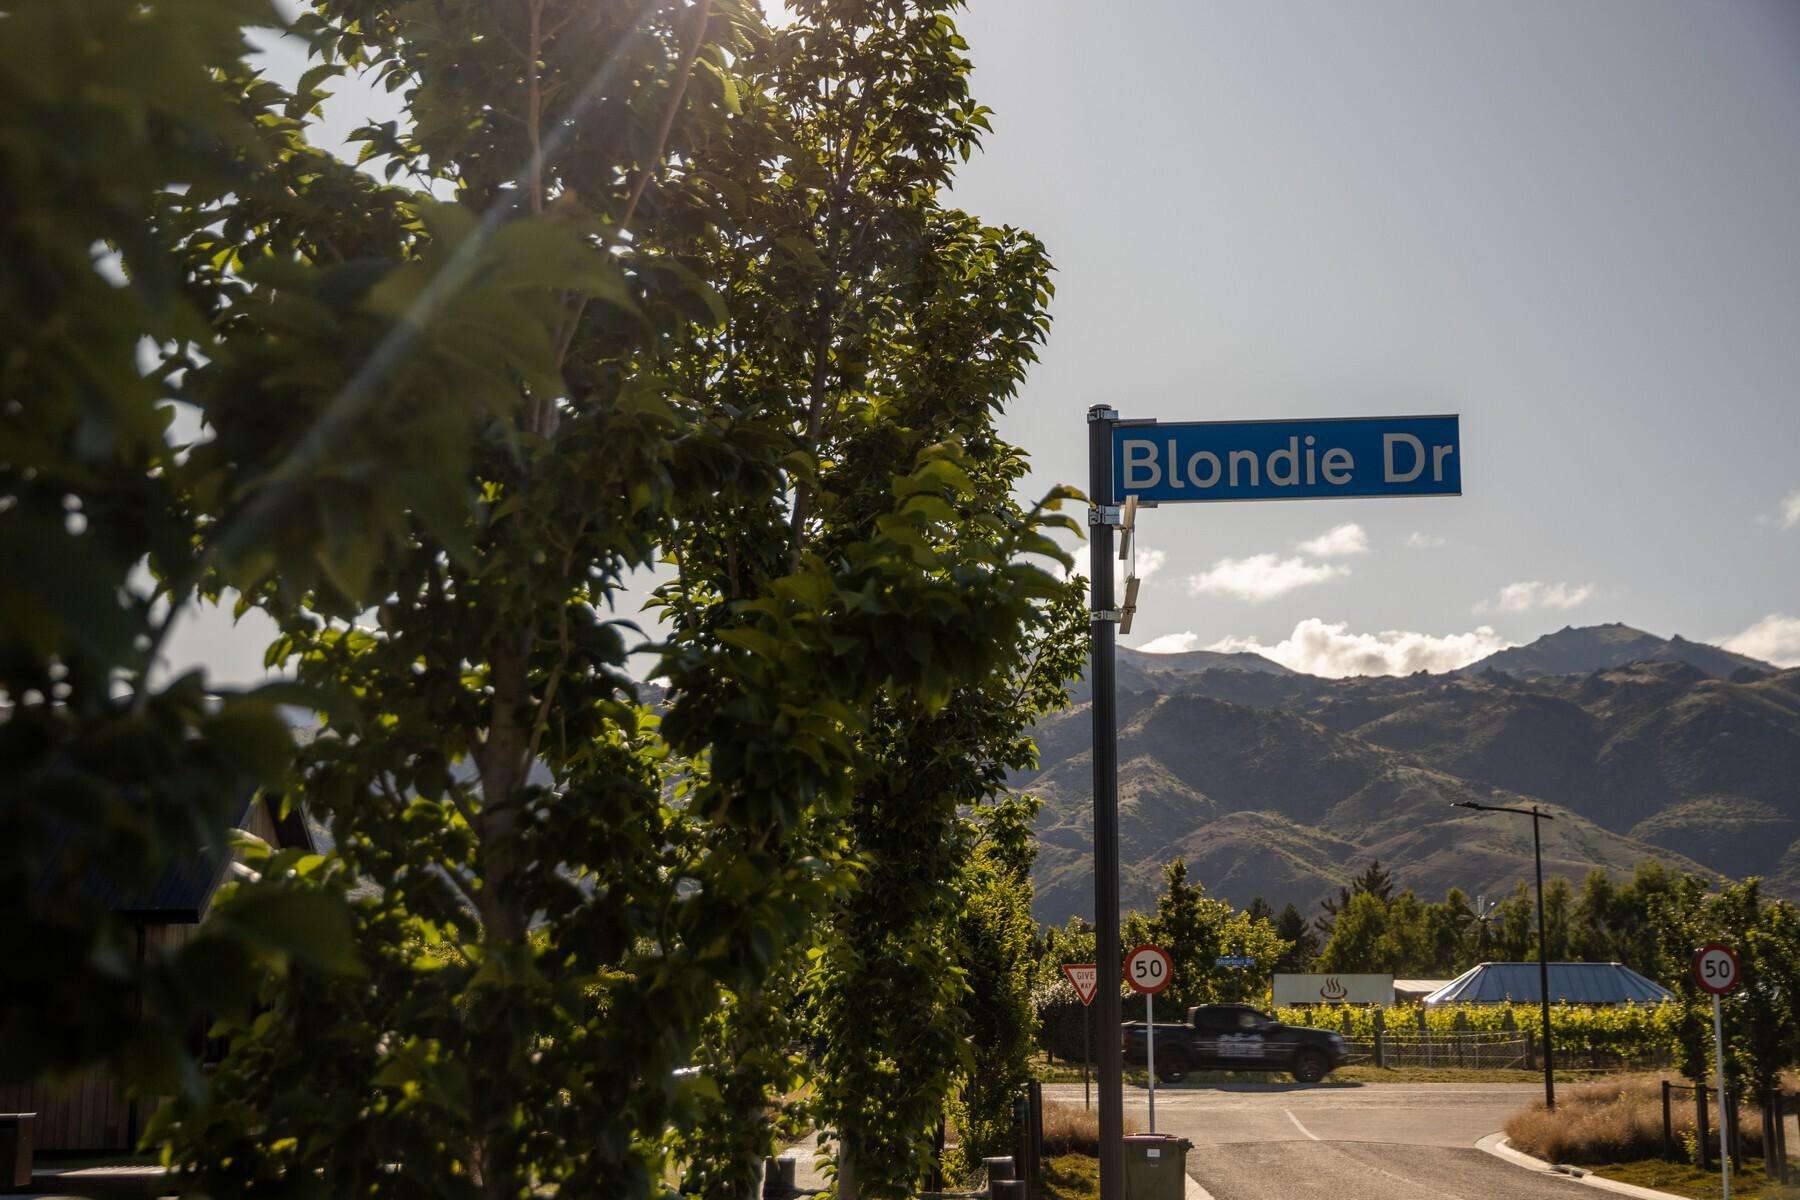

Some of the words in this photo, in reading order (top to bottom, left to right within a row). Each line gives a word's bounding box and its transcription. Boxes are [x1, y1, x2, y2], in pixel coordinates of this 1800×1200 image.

[1122, 435, 1355, 489] Blondie
[1382, 432, 1453, 483] Dr
[1077, 971, 1095, 980] GIVE
[1135, 959, 1163, 978] 50
[1705, 959, 1730, 978] 50
